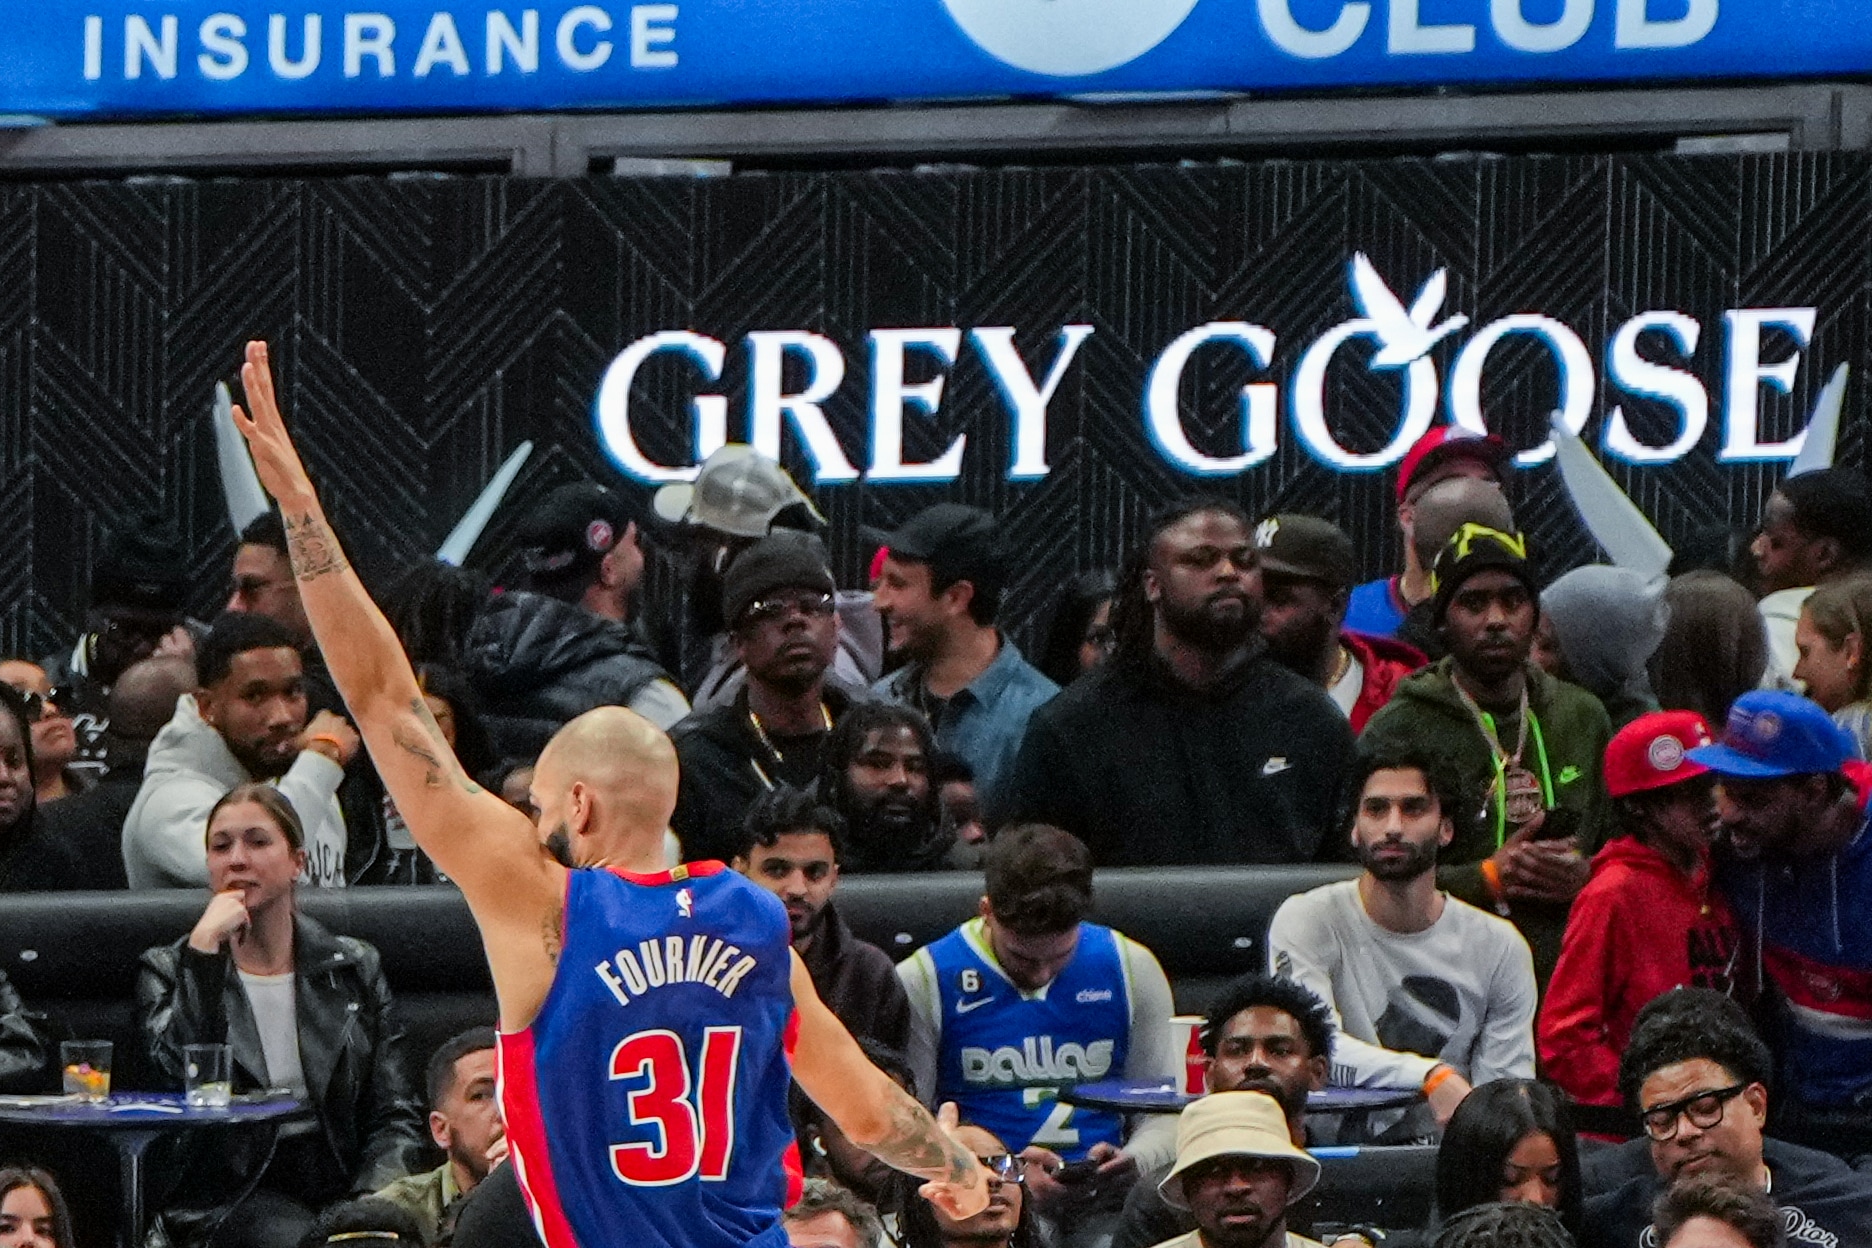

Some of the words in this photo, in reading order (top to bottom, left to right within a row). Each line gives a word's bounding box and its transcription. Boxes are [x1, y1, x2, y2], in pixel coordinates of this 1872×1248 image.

[84, 4, 679, 80] INSURANCE
[596, 324, 1095, 484] GREY
[1146, 305, 1819, 478] GOOSE
[594, 934, 757, 1007] FOURNIER
[961, 969, 980, 993] 6
[961, 1035, 1115, 1082] Dallas
[608, 1025, 742, 1188] 31
[1022, 1086, 1080, 1145] 2
